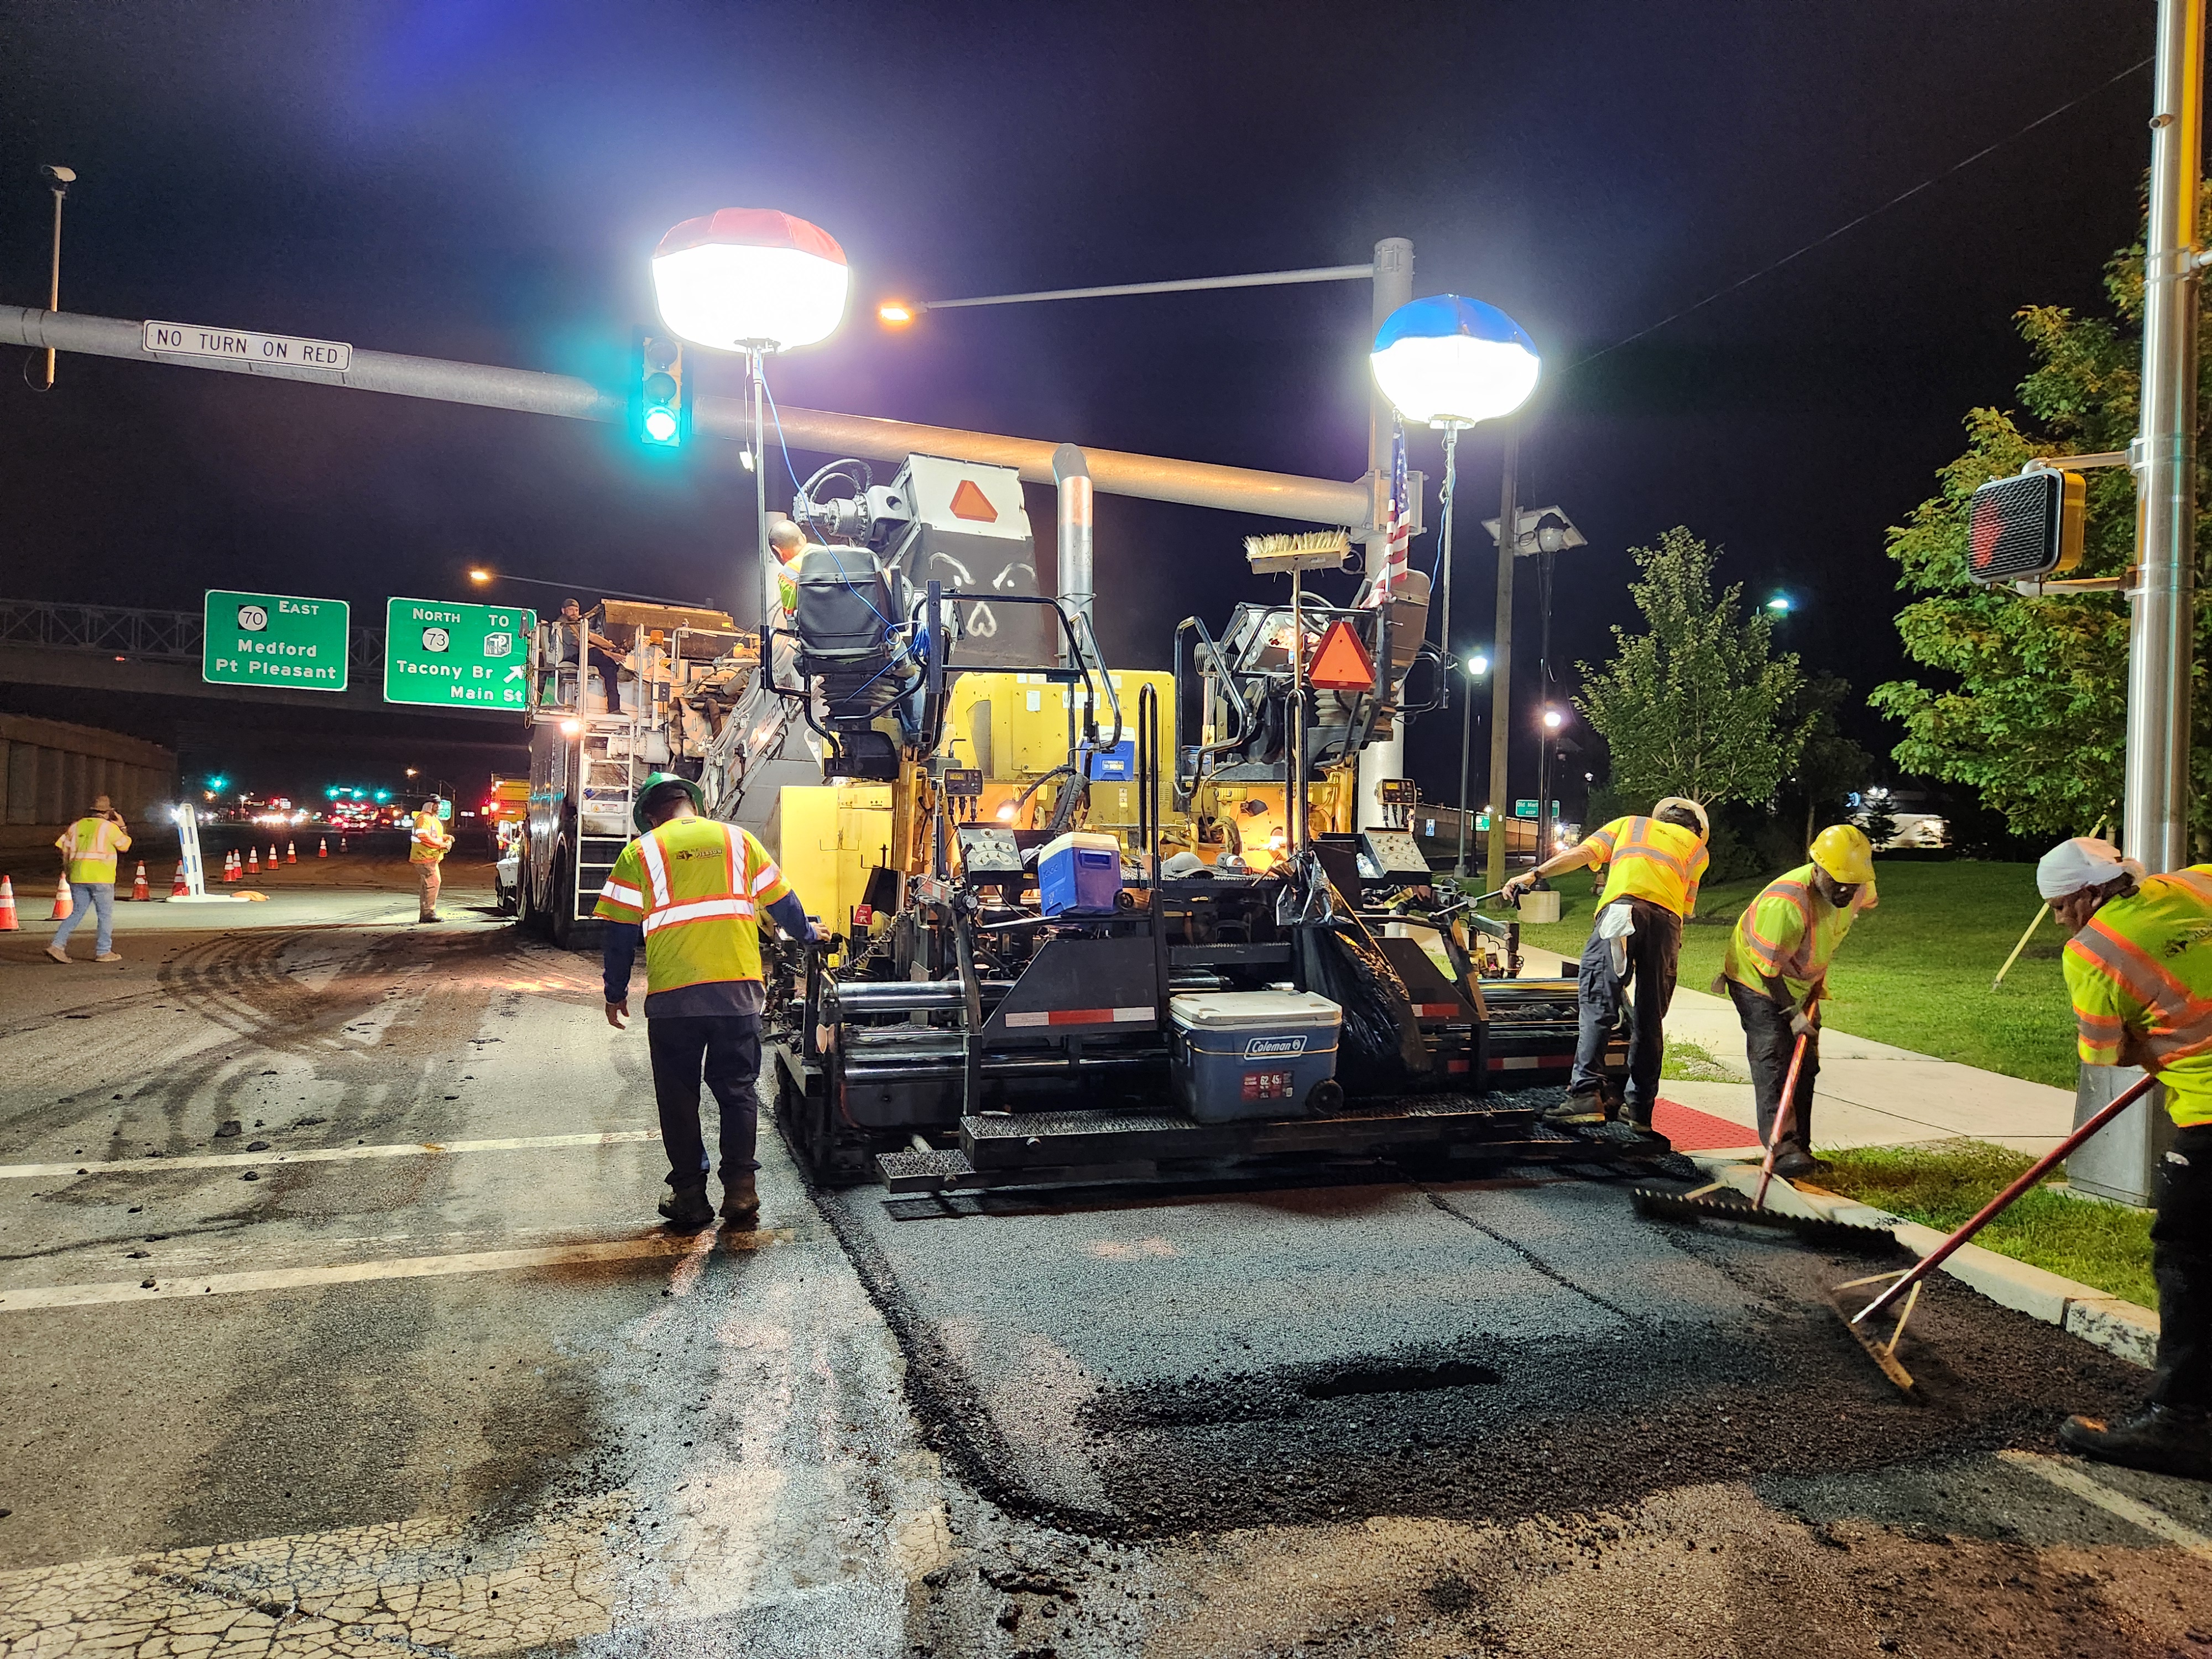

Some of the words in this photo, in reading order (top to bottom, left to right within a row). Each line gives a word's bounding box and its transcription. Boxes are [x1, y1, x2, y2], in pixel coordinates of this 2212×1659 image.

[157, 329, 181, 346] NO
[200, 333, 247, 354] TURN
[263, 341, 288, 358] ON
[303, 346, 338, 364] RED
[279, 600, 320, 615] EAST
[242, 611, 263, 625] 70
[413, 608, 461, 623] NORTH
[488, 614, 509, 627] TO
[238, 639, 317, 657] Medford
[427, 633, 445, 646] 73
[216, 658, 238, 672] Pt
[249, 660, 336, 679] Pleasant
[397, 660, 462, 680] Tacony
[472, 665, 493, 679] Br
[451, 685, 493, 701] Main
[503, 688, 523, 702] St
[1252, 1040, 1291, 1053] Coleman
